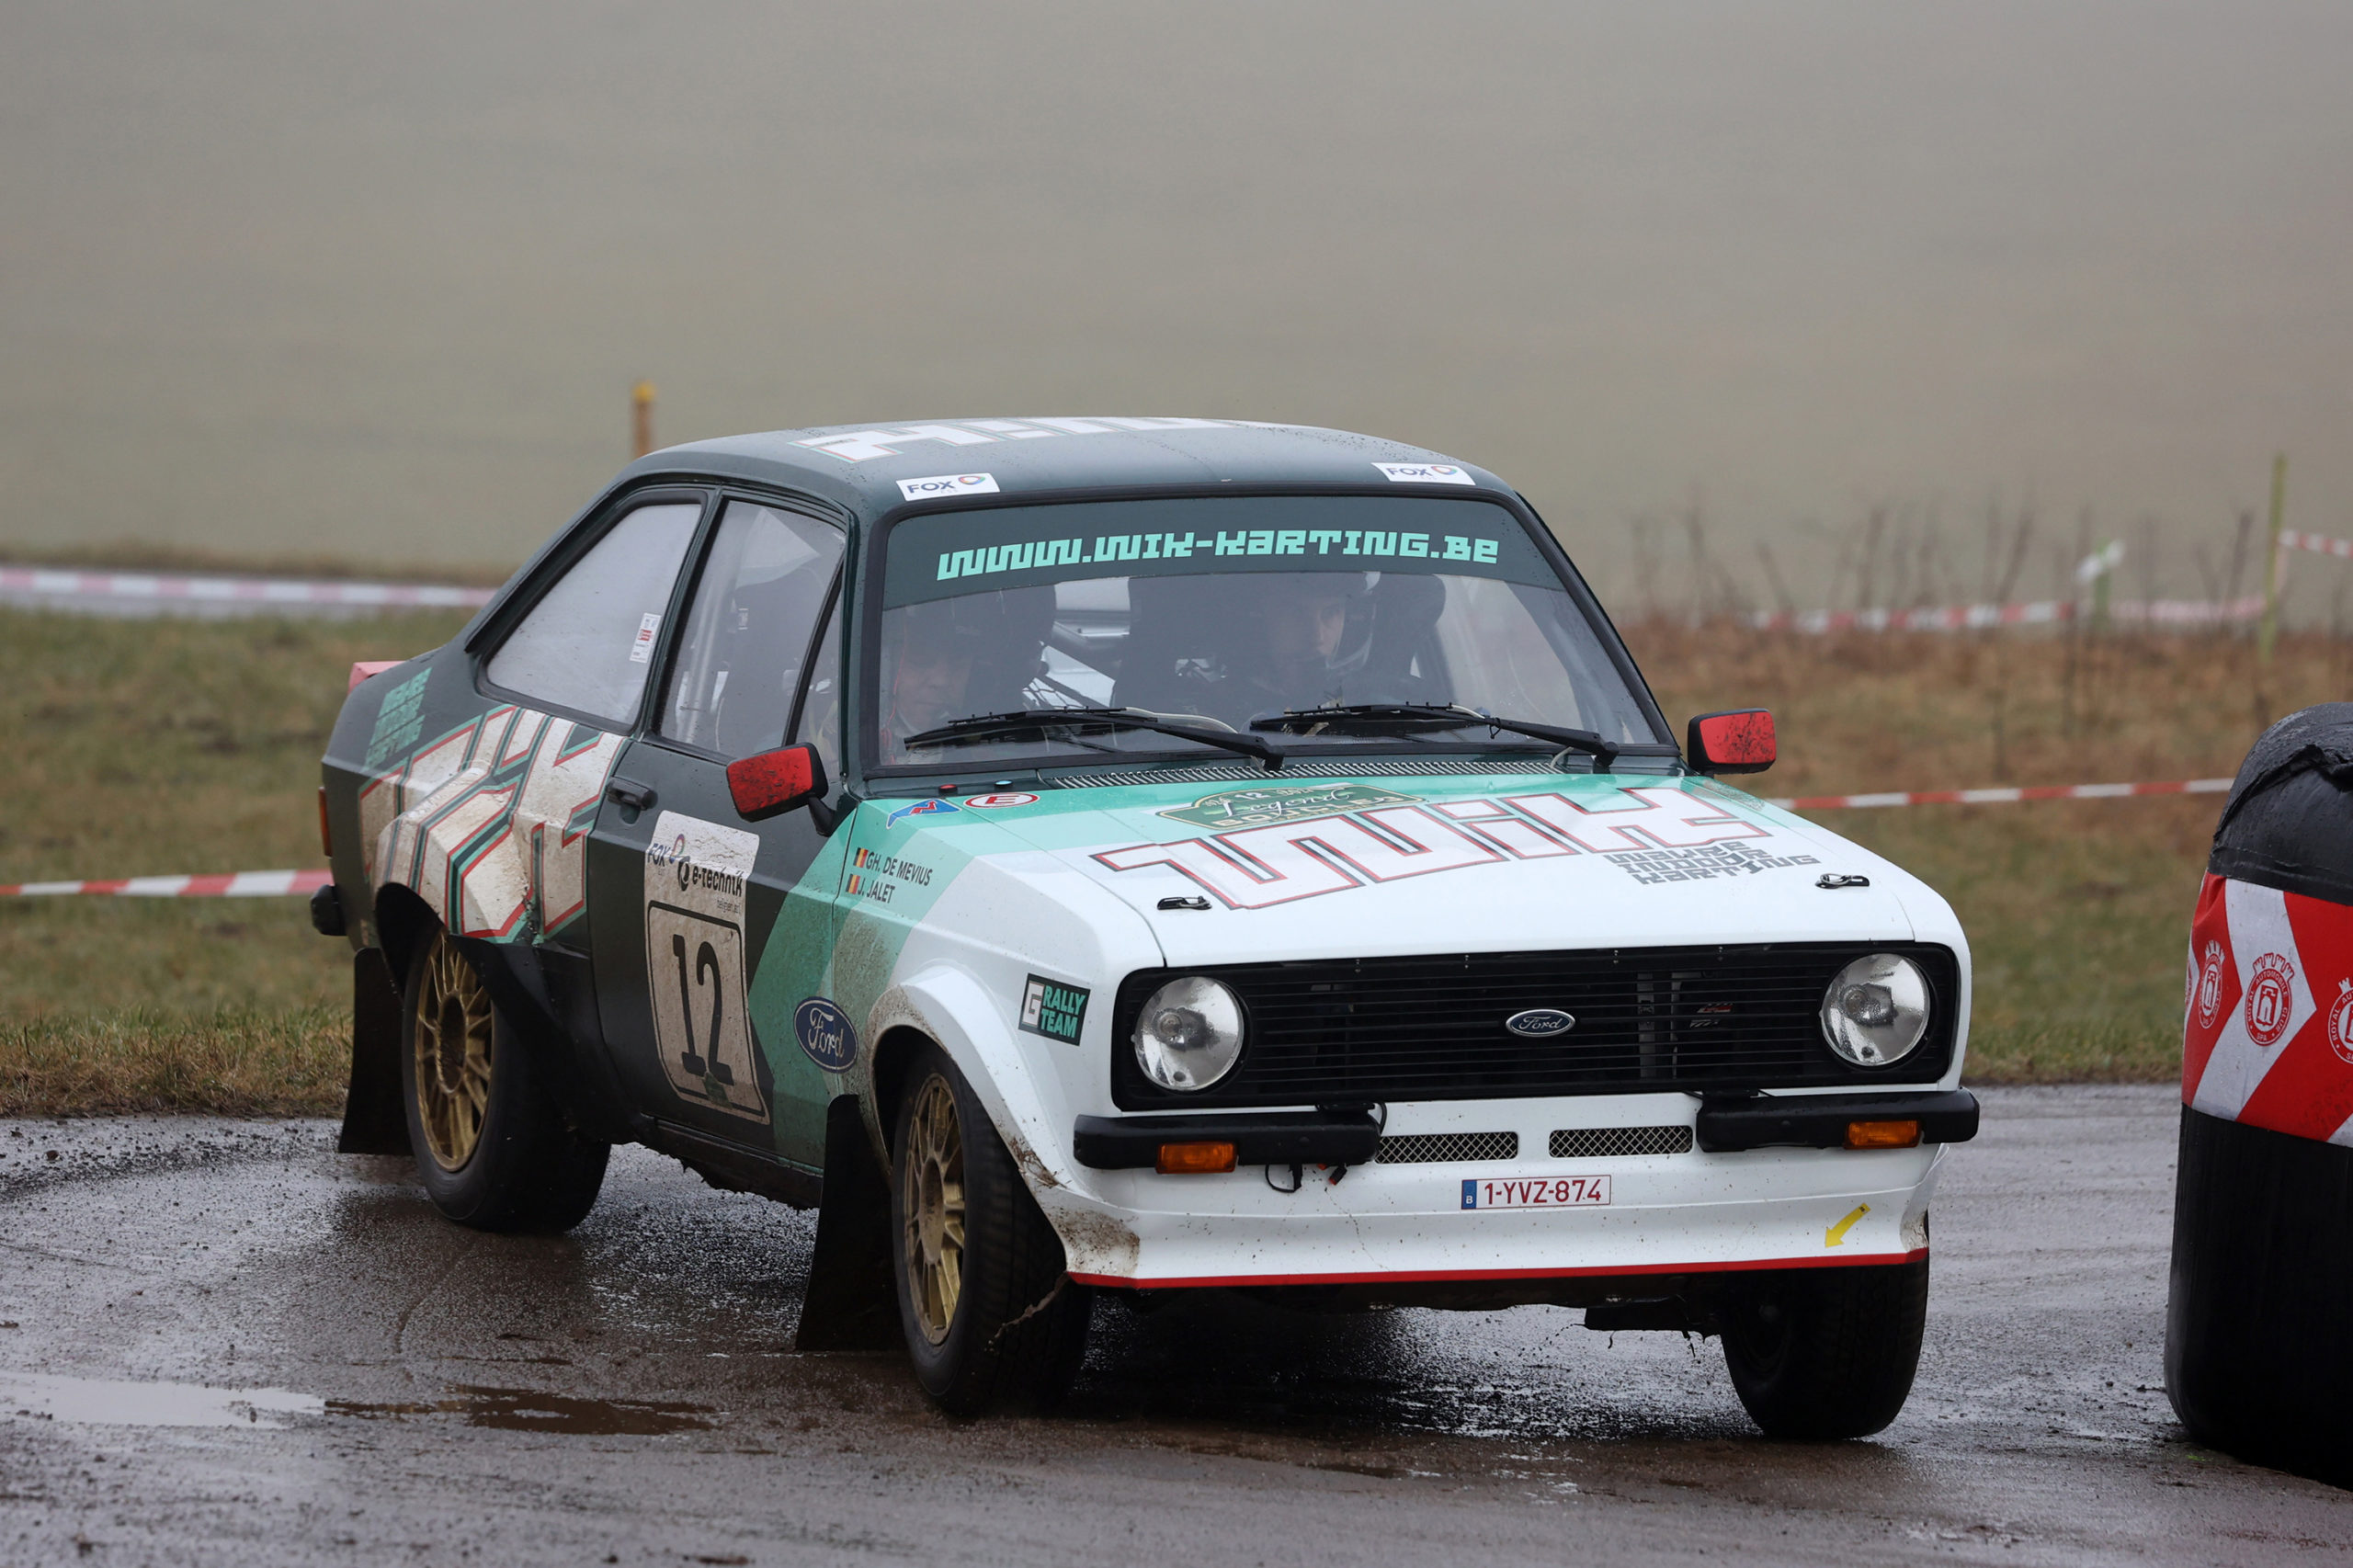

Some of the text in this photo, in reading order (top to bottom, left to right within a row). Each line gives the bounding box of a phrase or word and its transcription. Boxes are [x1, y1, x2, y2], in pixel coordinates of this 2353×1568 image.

[1386, 467, 1434, 476] FOX
[906, 480, 956, 494] FOX
[647, 843, 672, 867] FOX
[866, 851, 933, 886] GH. DE MEVIUS
[857, 877, 896, 903] J. JALET
[673, 934, 734, 1085] 12
[1042, 984, 1086, 1016] RALLY
[807, 1006, 847, 1058] Ford
[1040, 1008, 1079, 1039] TEAM
[1518, 1015, 1563, 1030] Ford
[2330, 1007, 2340, 1041] ROYAL
[1465, 1195, 1474, 1205] B
[1484, 1178, 1602, 1205] 1-YVZ-874
